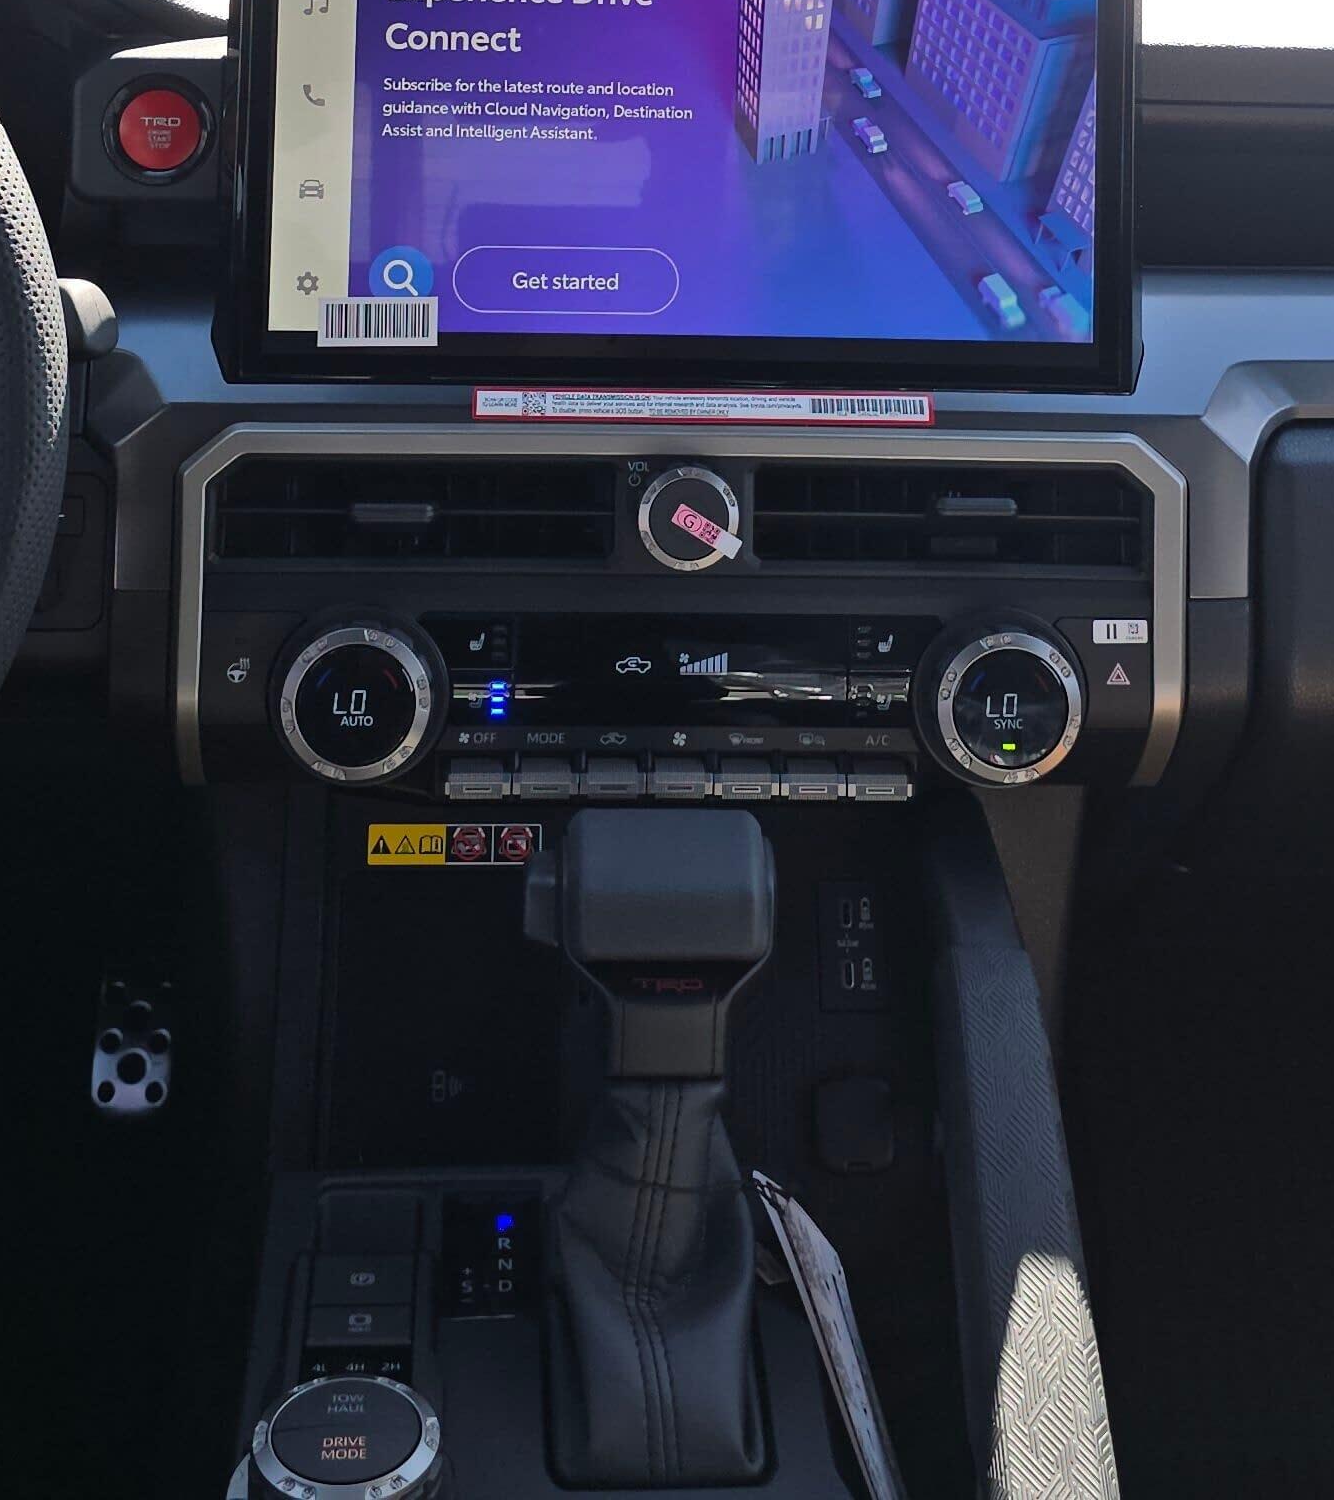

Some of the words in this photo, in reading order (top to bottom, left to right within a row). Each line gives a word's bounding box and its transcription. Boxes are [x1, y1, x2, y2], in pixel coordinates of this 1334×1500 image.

[385, 22, 522, 52] Connect
[383, 78, 452, 93] Subscribe
[455, 79, 476, 93] for
[478, 79, 501, 93] the
[504, 80, 544, 95] latest
[546, 82, 584, 95] route
[587, 82, 614, 96] and
[617, 82, 674, 97] location
[382, 101, 449, 119] guidance
[451, 102, 482, 116] with
[485, 102, 528, 117] Cloud
[530, 103, 610, 120] Navigation,
[614, 105, 693, 120] Destination
[140, 116, 181, 127] TRD
[382, 124, 422, 138] Assist
[425, 124, 453, 138] and
[456, 125, 528, 142] Intelligent
[530, 125, 598, 141] Assistant.
[512, 271, 548, 289] Get
[552, 272, 619, 290] started
[627, 461, 649, 472] VOL
[333, 689, 367, 715] LO
[985, 693, 1018, 718] LO
[340, 716, 374, 727] AUTO
[994, 719, 1023, 730] SYNC
[473, 732, 497, 744] OFF
[526, 732, 566, 744] MODE
[865, 735, 891, 747] A/C
[498, 1237, 512, 1250] R
[498, 1258, 513, 1271] N
[498, 1279, 513, 1292] D
[346, 1363, 365, 1372] 4H
[322, 1436, 366, 1447] DRIVE
[321, 1448, 366, 1461] MODE
